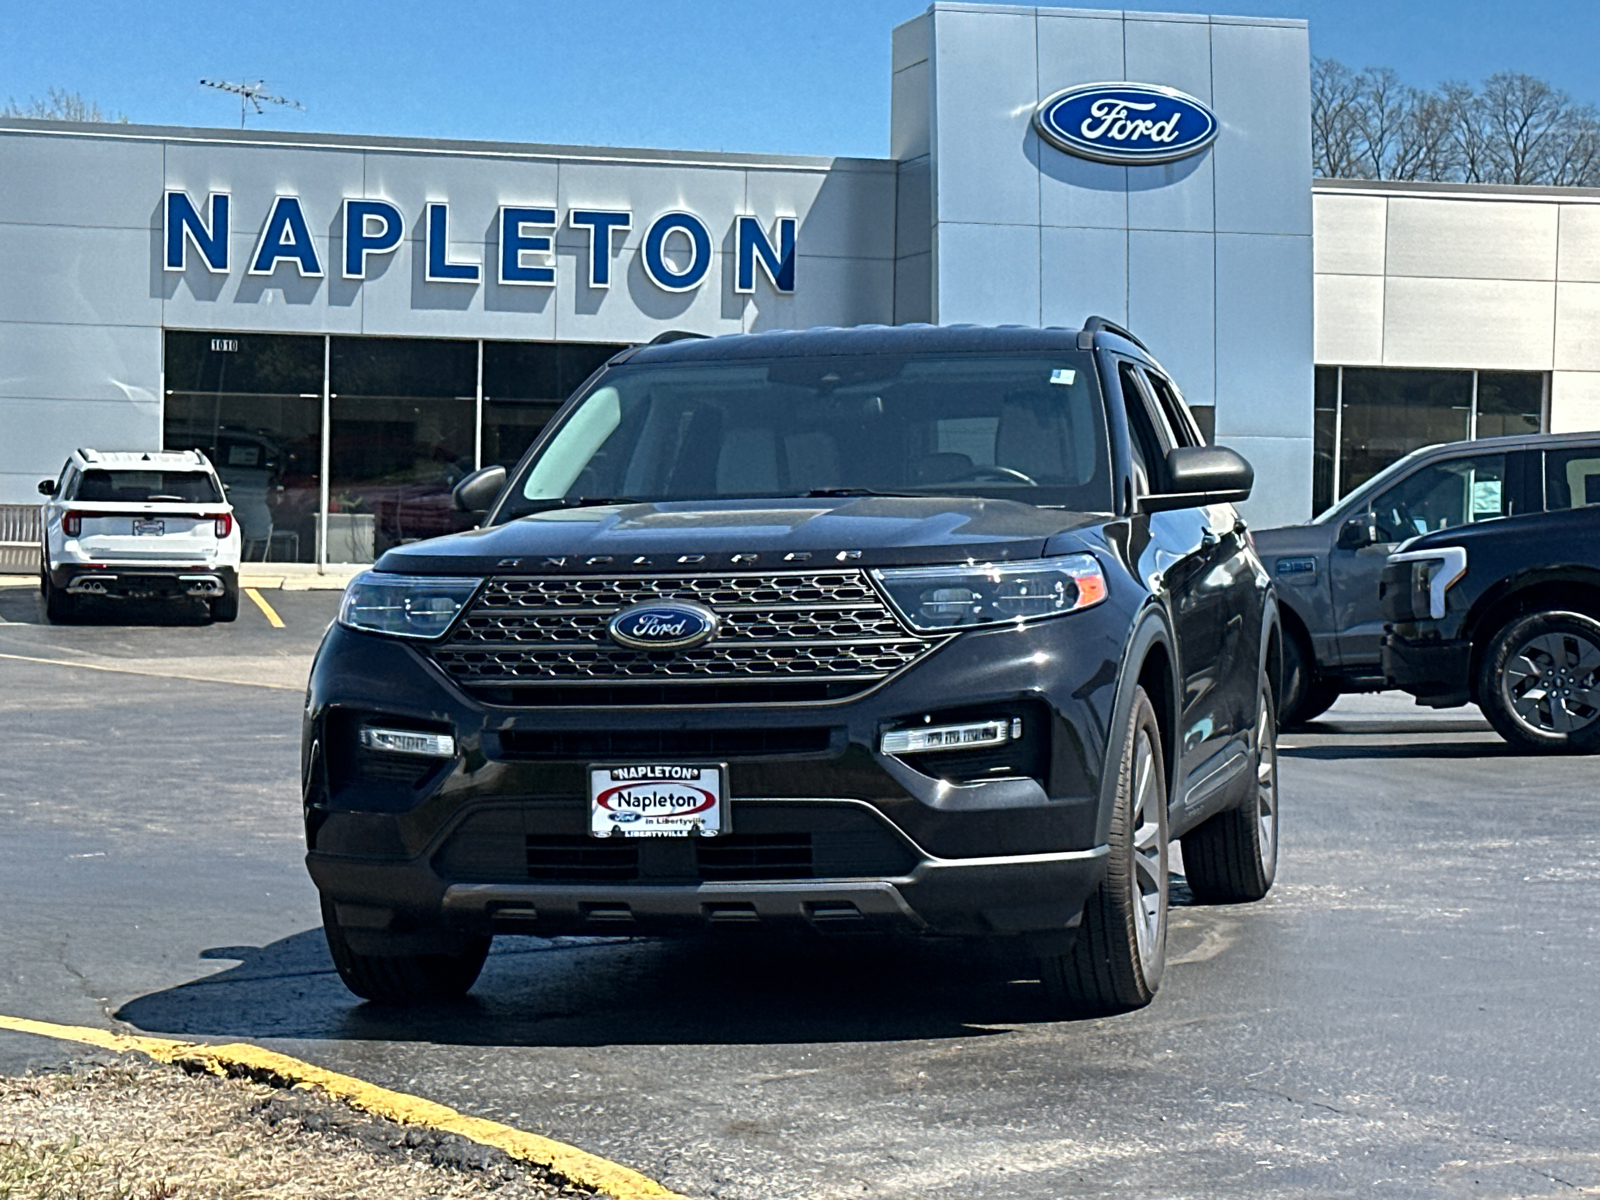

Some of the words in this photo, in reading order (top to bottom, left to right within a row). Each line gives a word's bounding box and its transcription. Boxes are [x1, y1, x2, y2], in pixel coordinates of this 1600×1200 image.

[1081, 99, 1181, 142] Ford
[163, 190, 797, 295] NAPLETON
[212, 339, 238, 352] 1010
[633, 613, 687, 637] Ford
[618, 766, 691, 779] NAPLETON
[618, 791, 696, 811] Napleton
[624, 830, 689, 838] LIBERTYVILLE
